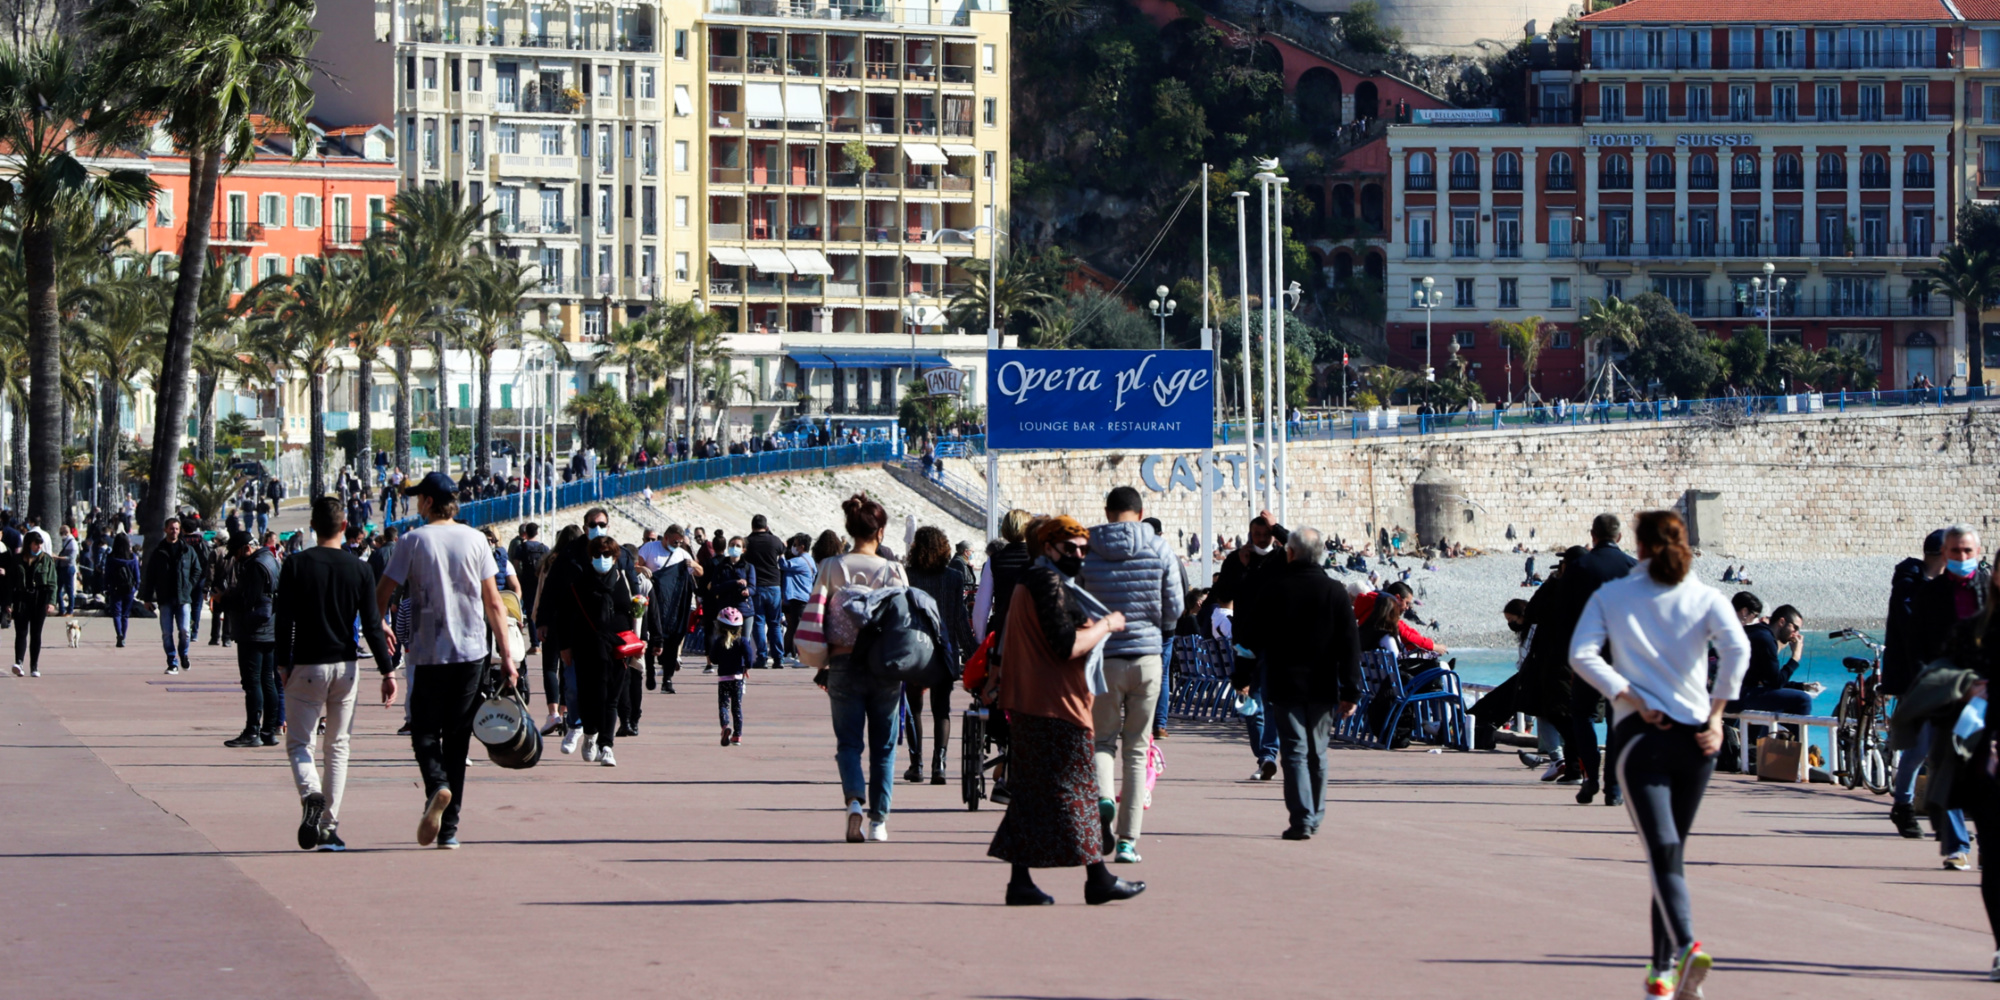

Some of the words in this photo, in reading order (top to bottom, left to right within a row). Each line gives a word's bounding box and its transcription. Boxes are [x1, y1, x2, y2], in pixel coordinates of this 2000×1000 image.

[1589, 134, 1656, 147] HOTEL
[1676, 134, 1753, 147] SUISSE
[928, 371, 959, 392] CASTEL
[997, 360, 1102, 405] Opera
[1114, 354, 1209, 411] plage
[1019, 421, 1069, 431] LOUNGE
[1073, 421, 1095, 431] BAR
[1107, 421, 1181, 431] RESTAURANT
